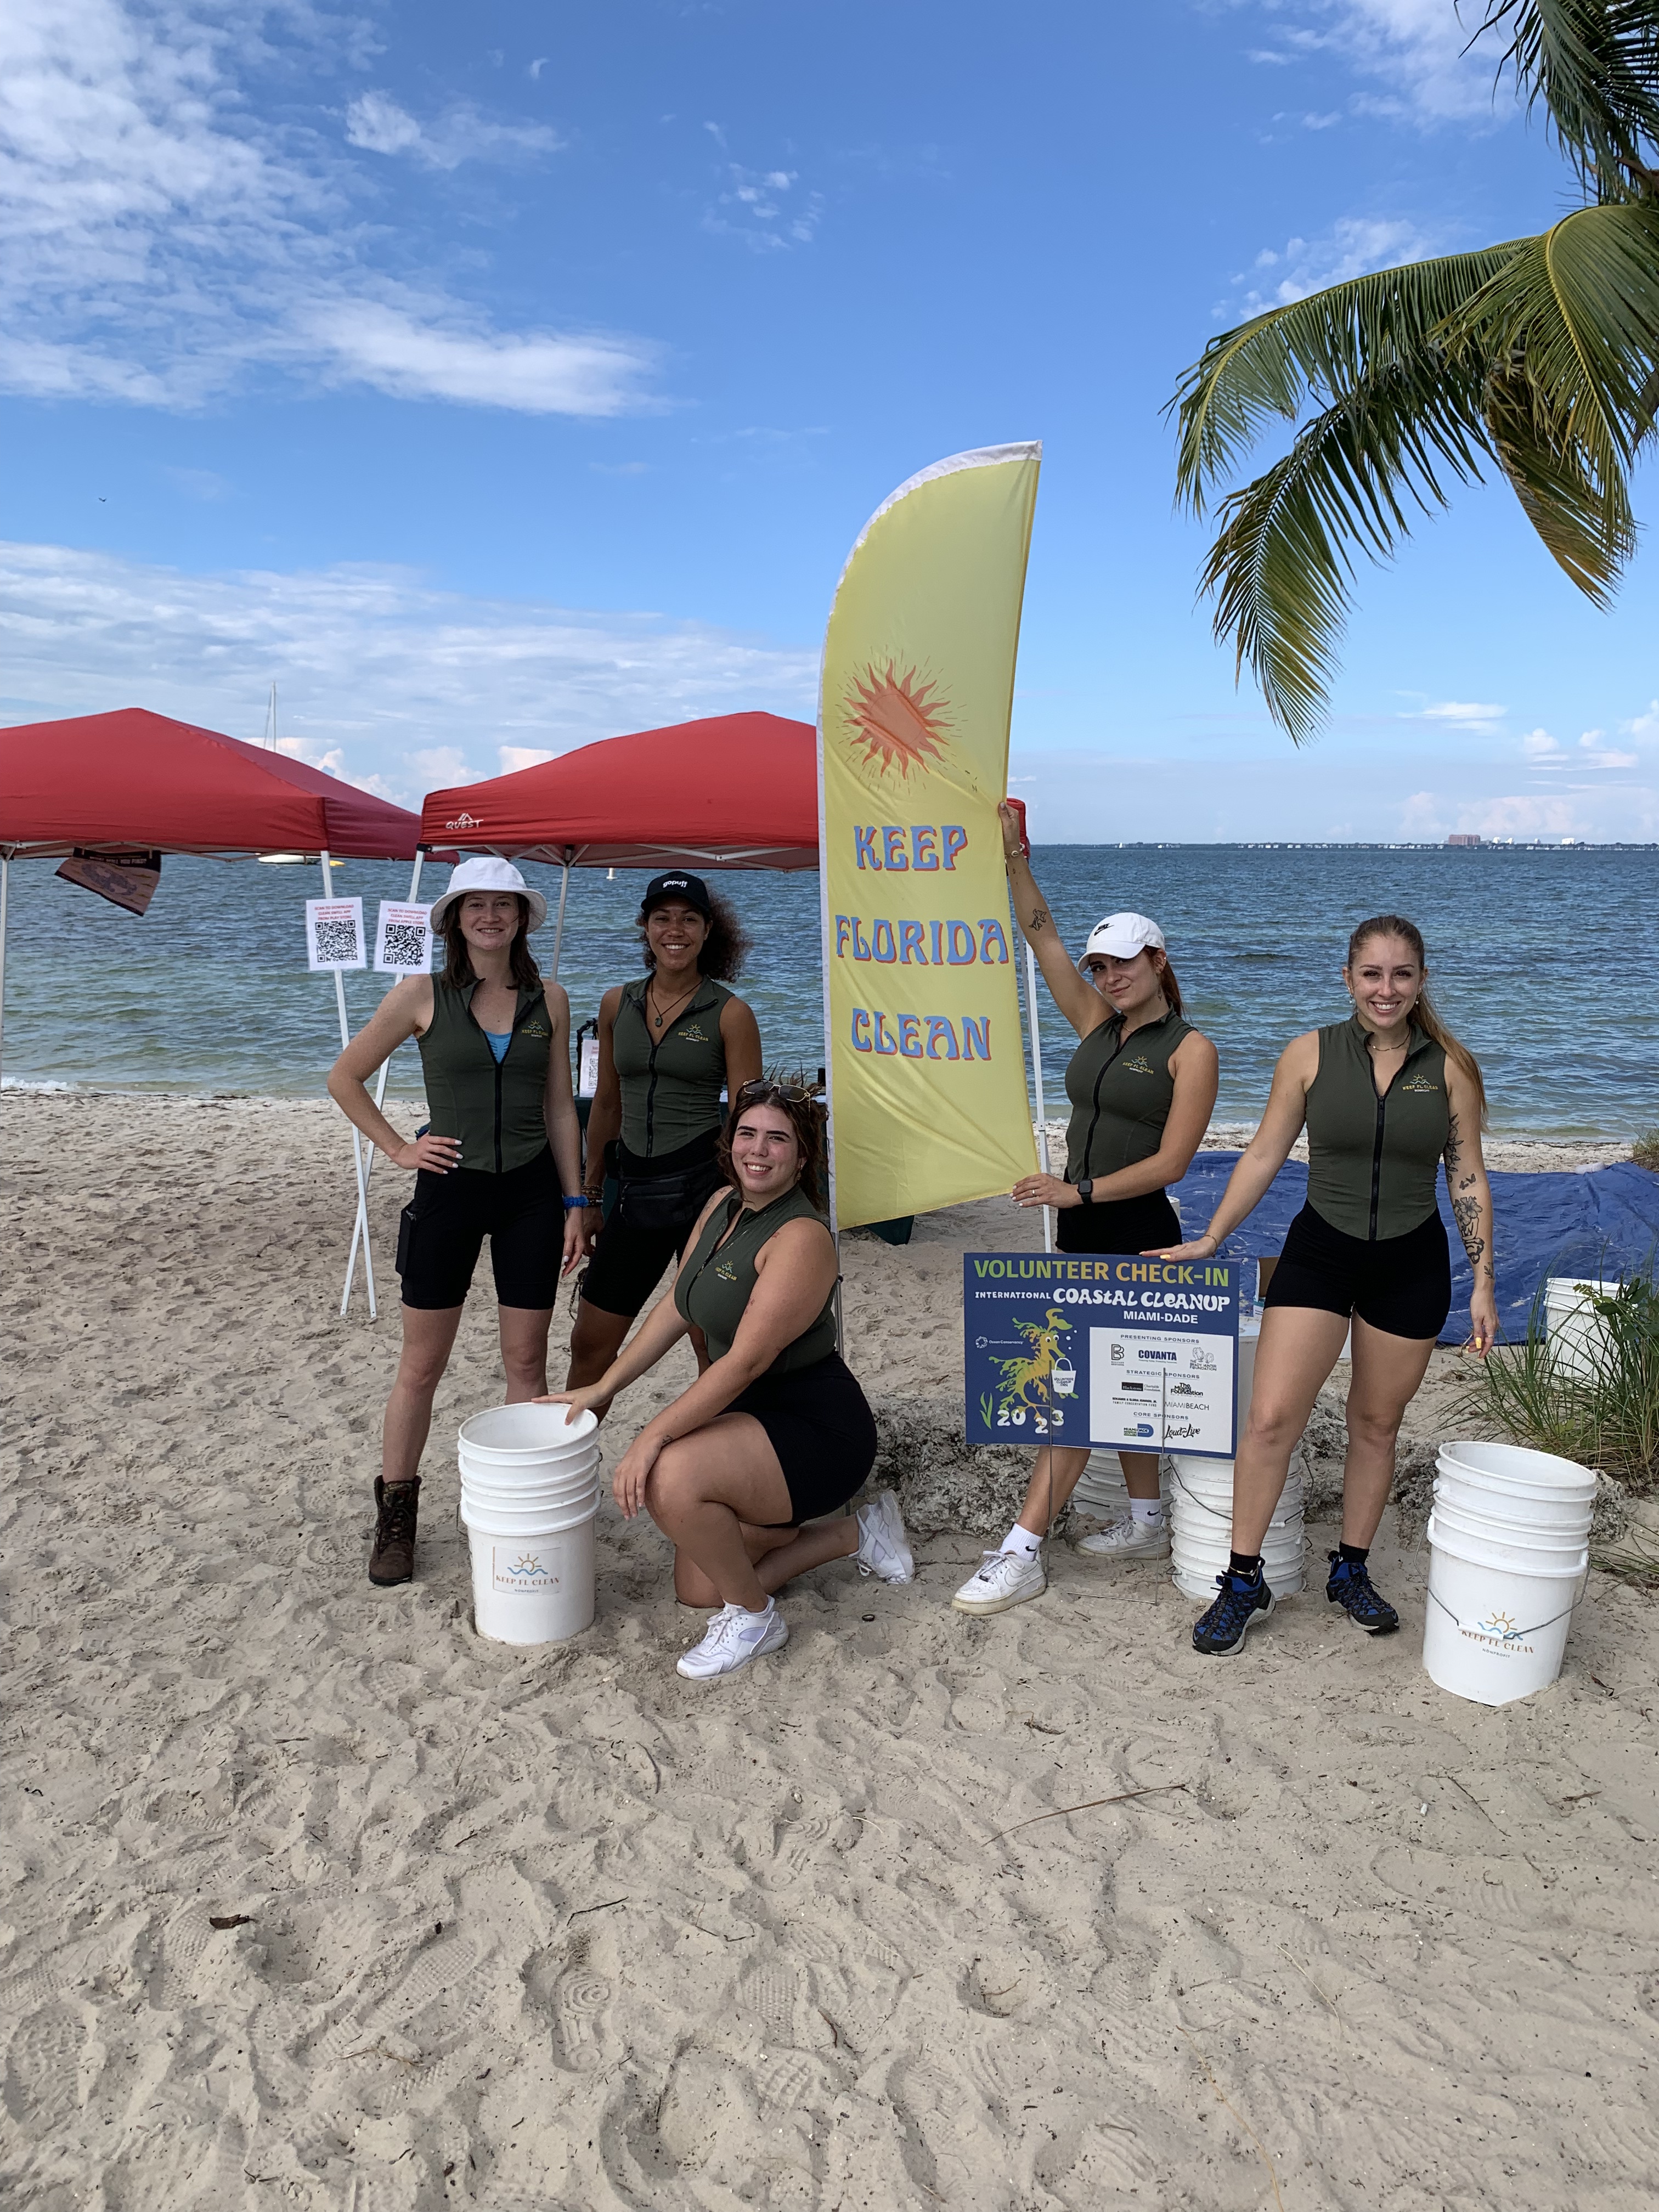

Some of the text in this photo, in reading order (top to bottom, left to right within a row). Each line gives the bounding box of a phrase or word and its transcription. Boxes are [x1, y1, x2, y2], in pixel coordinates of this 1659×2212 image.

[445, 819, 483, 830] QUEST
[854, 825, 968, 872] KEEP
[835, 915, 1009, 966] FLORIDA
[851, 1007, 991, 1060] CLEAN
[974, 1260, 1229, 1287] VOLUNTEER CHECK-IN
[1124, 1311, 1198, 1324] MIAMI-DADE
[1138, 1350, 1177, 1361] COVANTA
[1162, 1423, 1200, 1439] Loud Live
[496, 1575, 516, 1584] KEEP
[532, 1577, 560, 1586] CLEAN
[1462, 1630, 1534, 1654] KEEP FL CLEAN
[1482, 1648, 1510, 1658] NONPROFIT
